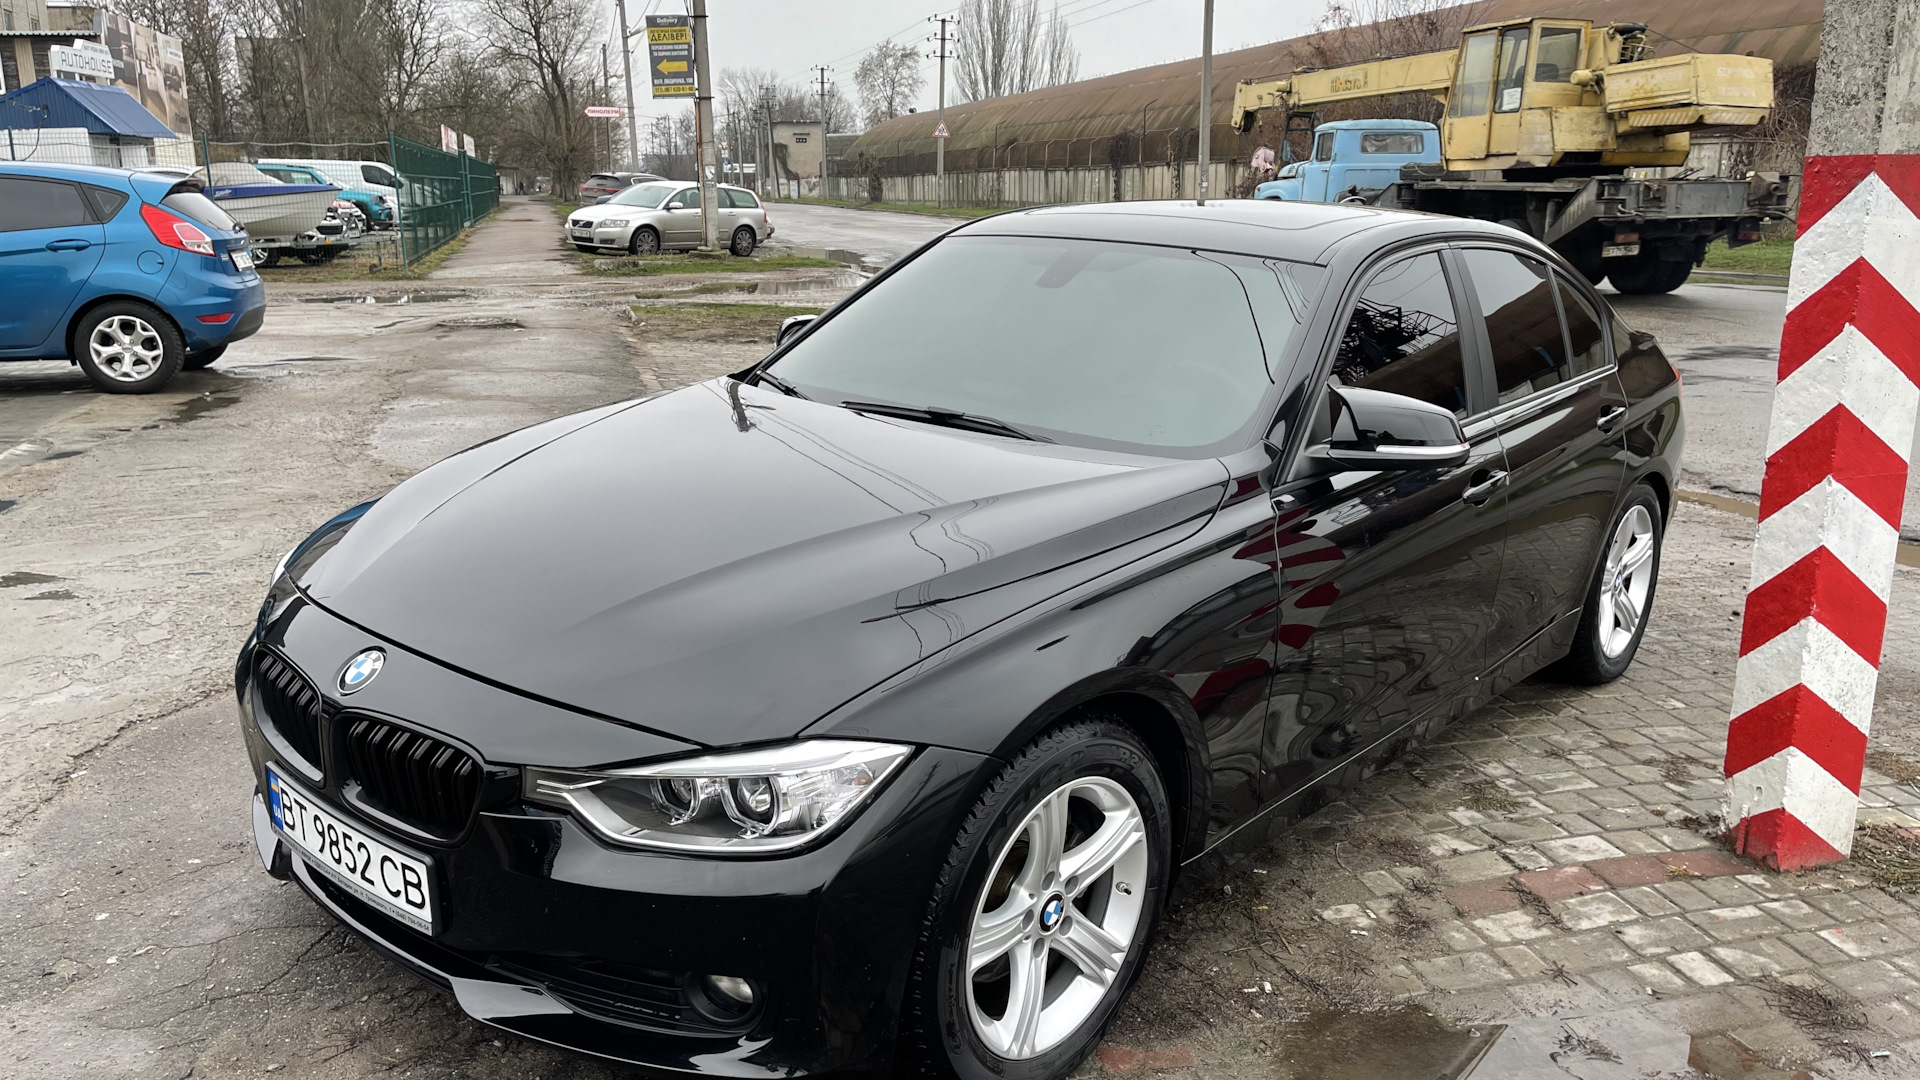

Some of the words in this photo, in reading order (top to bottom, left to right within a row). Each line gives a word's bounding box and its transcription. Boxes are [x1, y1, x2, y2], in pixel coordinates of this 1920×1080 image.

[650, 33, 687, 42] ДЕЛІВЕРІ
[60, 51, 113, 74] AUTOHOUSE
[273, 803, 283, 820] UA
[313, 814, 375, 887] 9852
